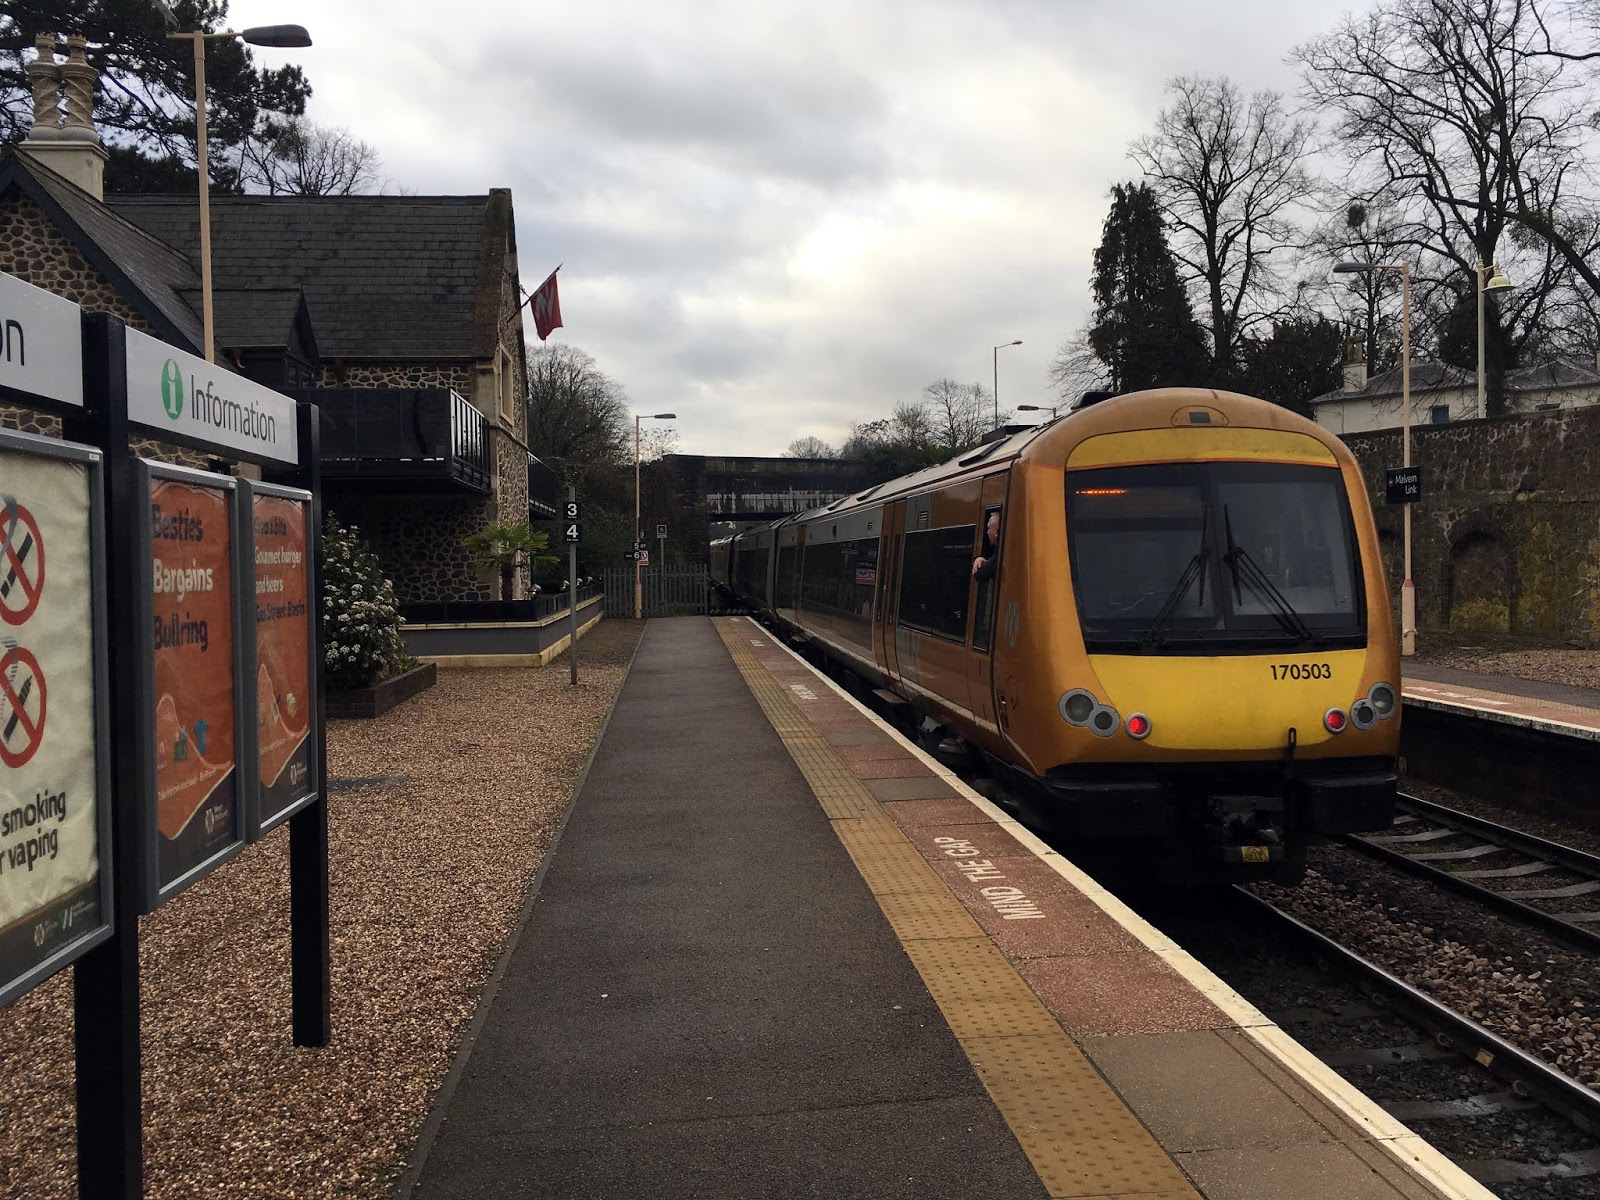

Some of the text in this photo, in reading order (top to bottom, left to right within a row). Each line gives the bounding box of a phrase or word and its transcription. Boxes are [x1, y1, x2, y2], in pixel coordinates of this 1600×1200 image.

[0, 318, 25, 367] n
[191, 374, 276, 444] Information
[1395, 474, 1418, 484] Malvern
[1405, 484, 1418, 495] Link
[567, 503, 578, 516] 3
[152, 504, 203, 542] Besties
[566, 524, 579, 538] 4
[633, 551, 640, 559] 6
[634, 542, 640, 550] 5
[255, 546, 302, 569] Gourmet burger
[153, 559, 213, 603] Bargains
[256, 574, 284, 594] and beers
[267, 602, 287, 620] Street
[287, 599, 305, 618] Basin
[154, 611, 208, 652] Bullring
[1270, 663, 1332, 681] 170503
[2, 789, 66, 837] smoking
[8, 828, 58, 872] vaping
[934, 836, 1046, 920] MIND THE GAP
